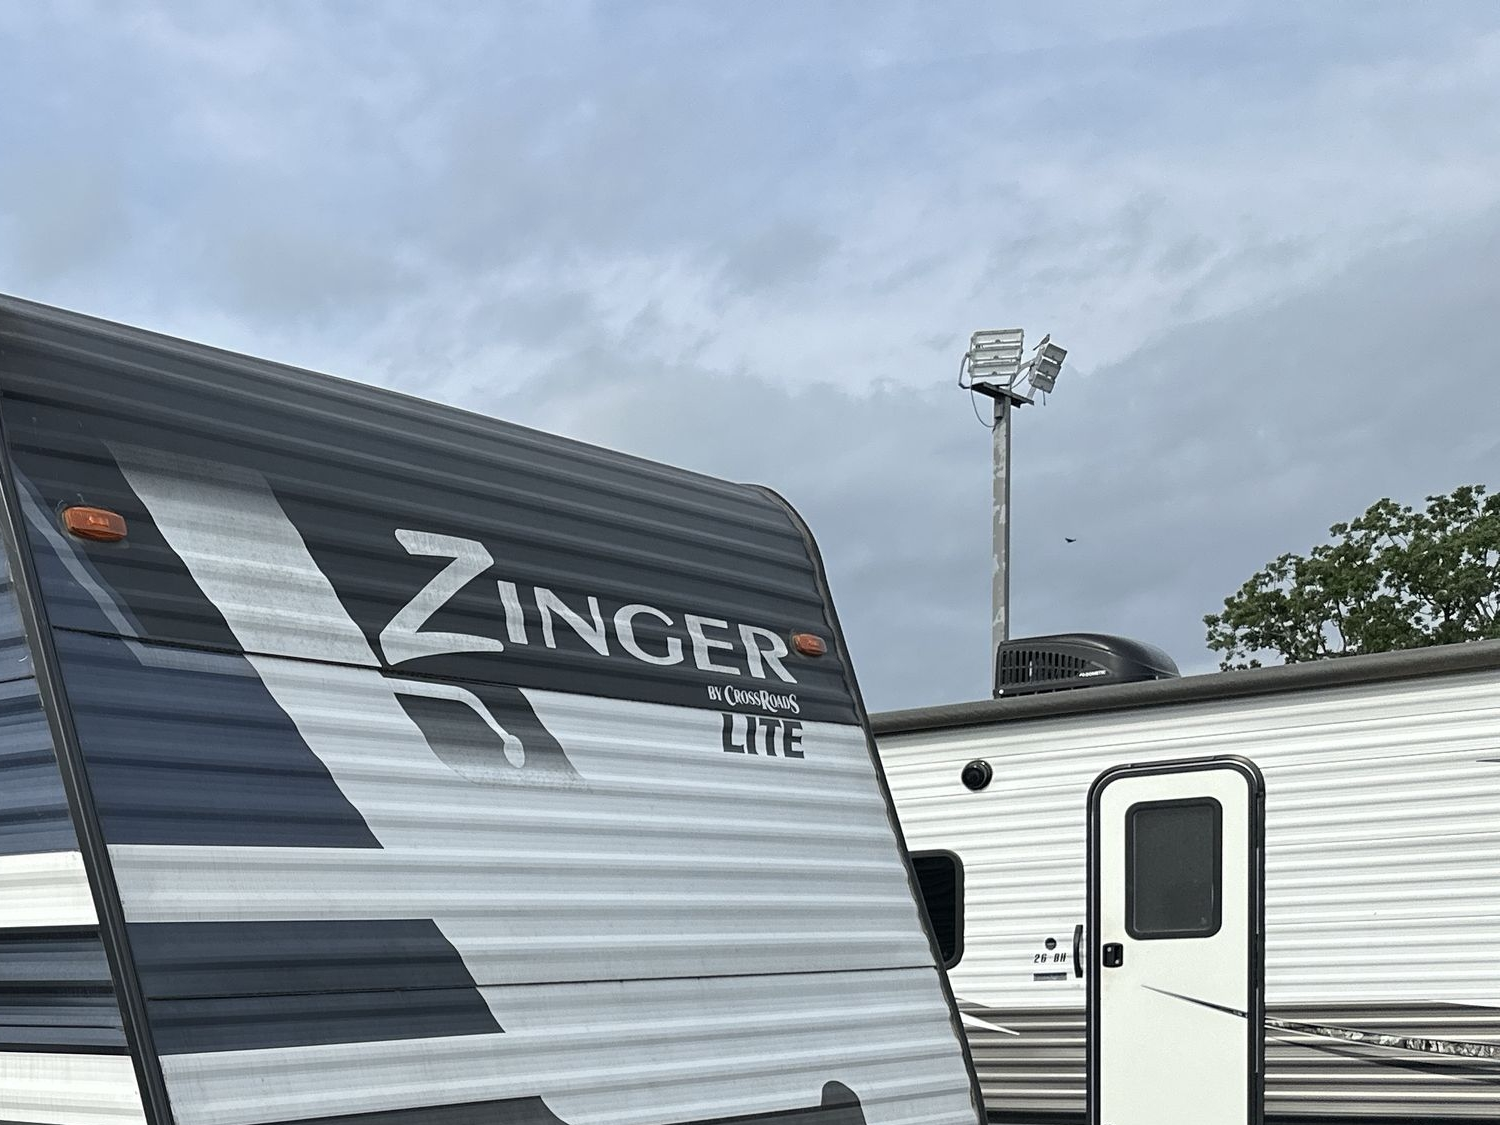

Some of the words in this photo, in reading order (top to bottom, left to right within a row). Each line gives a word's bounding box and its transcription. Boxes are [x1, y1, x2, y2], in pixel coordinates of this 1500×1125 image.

[379, 528, 798, 684] ZINGER
[708, 685, 722, 701] BY
[721, 713, 805, 759] LITE
[1033, 953, 1047, 963] 26
